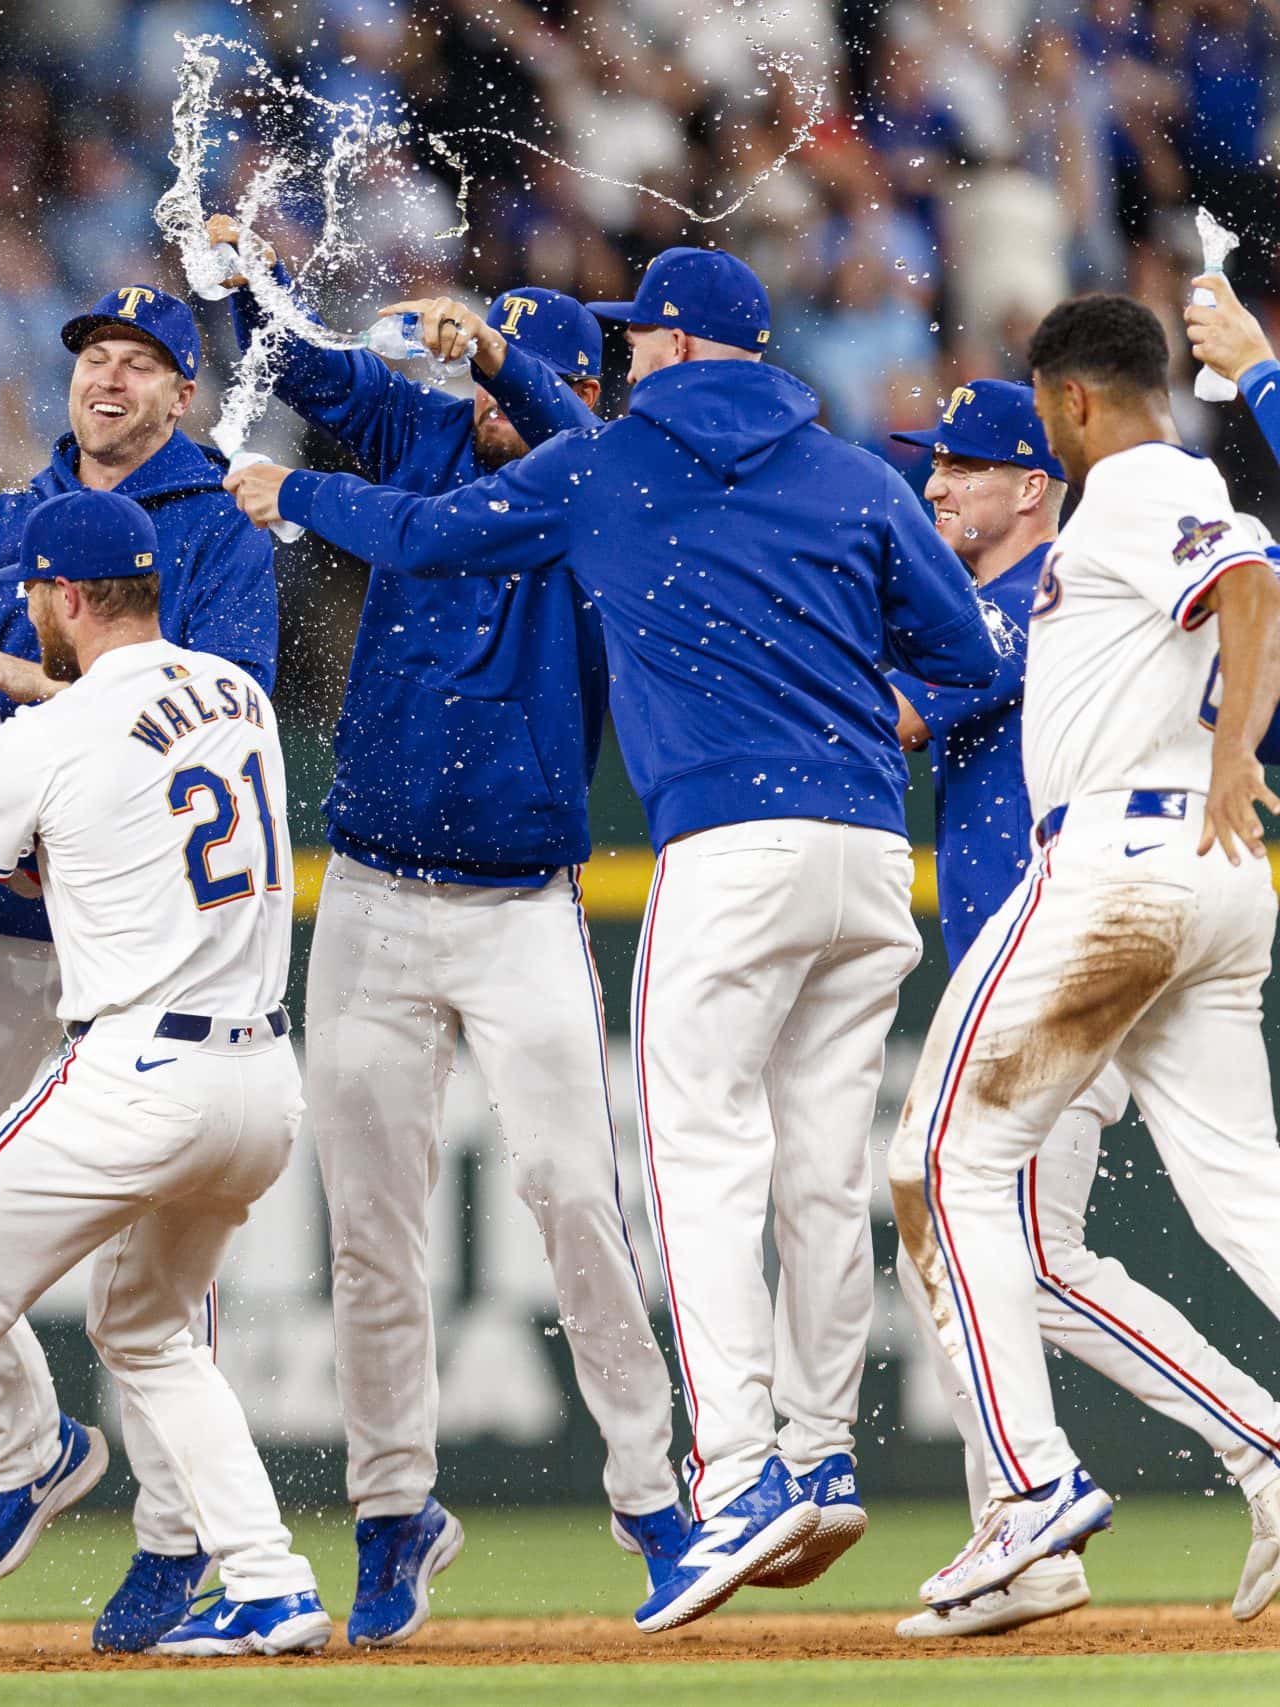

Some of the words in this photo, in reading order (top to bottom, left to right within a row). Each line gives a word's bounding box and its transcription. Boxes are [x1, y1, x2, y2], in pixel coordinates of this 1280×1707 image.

[118, 285, 154, 320] T
[500, 296, 537, 335] T
[942, 386, 976, 425] T
[130, 678, 265, 755] WALSH
[168, 751, 281, 911] 21
